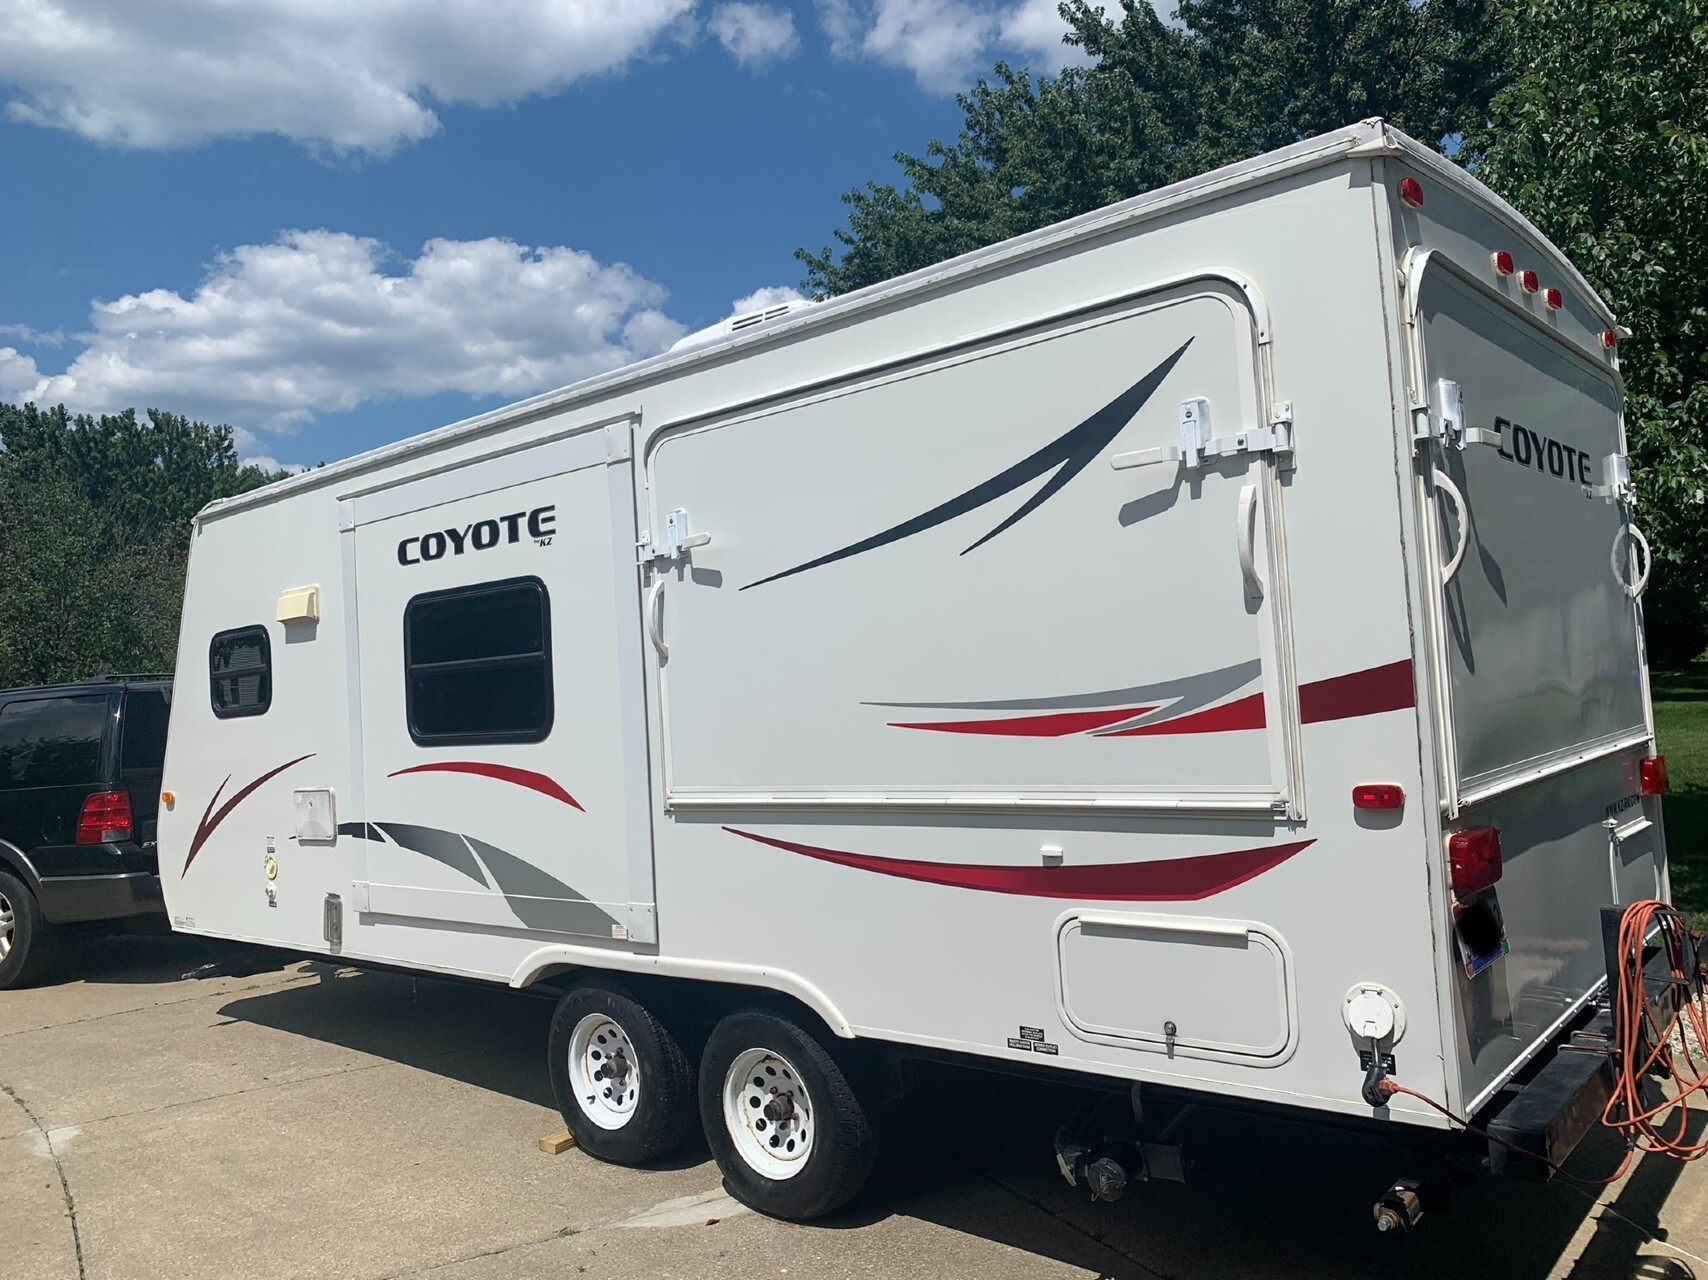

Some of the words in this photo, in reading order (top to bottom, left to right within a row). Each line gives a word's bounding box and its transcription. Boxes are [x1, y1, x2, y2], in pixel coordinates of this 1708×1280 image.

[1494, 416, 1592, 487] COYOTE
[397, 505, 556, 566] COYOTE
[540, 537, 553, 547] KZ
